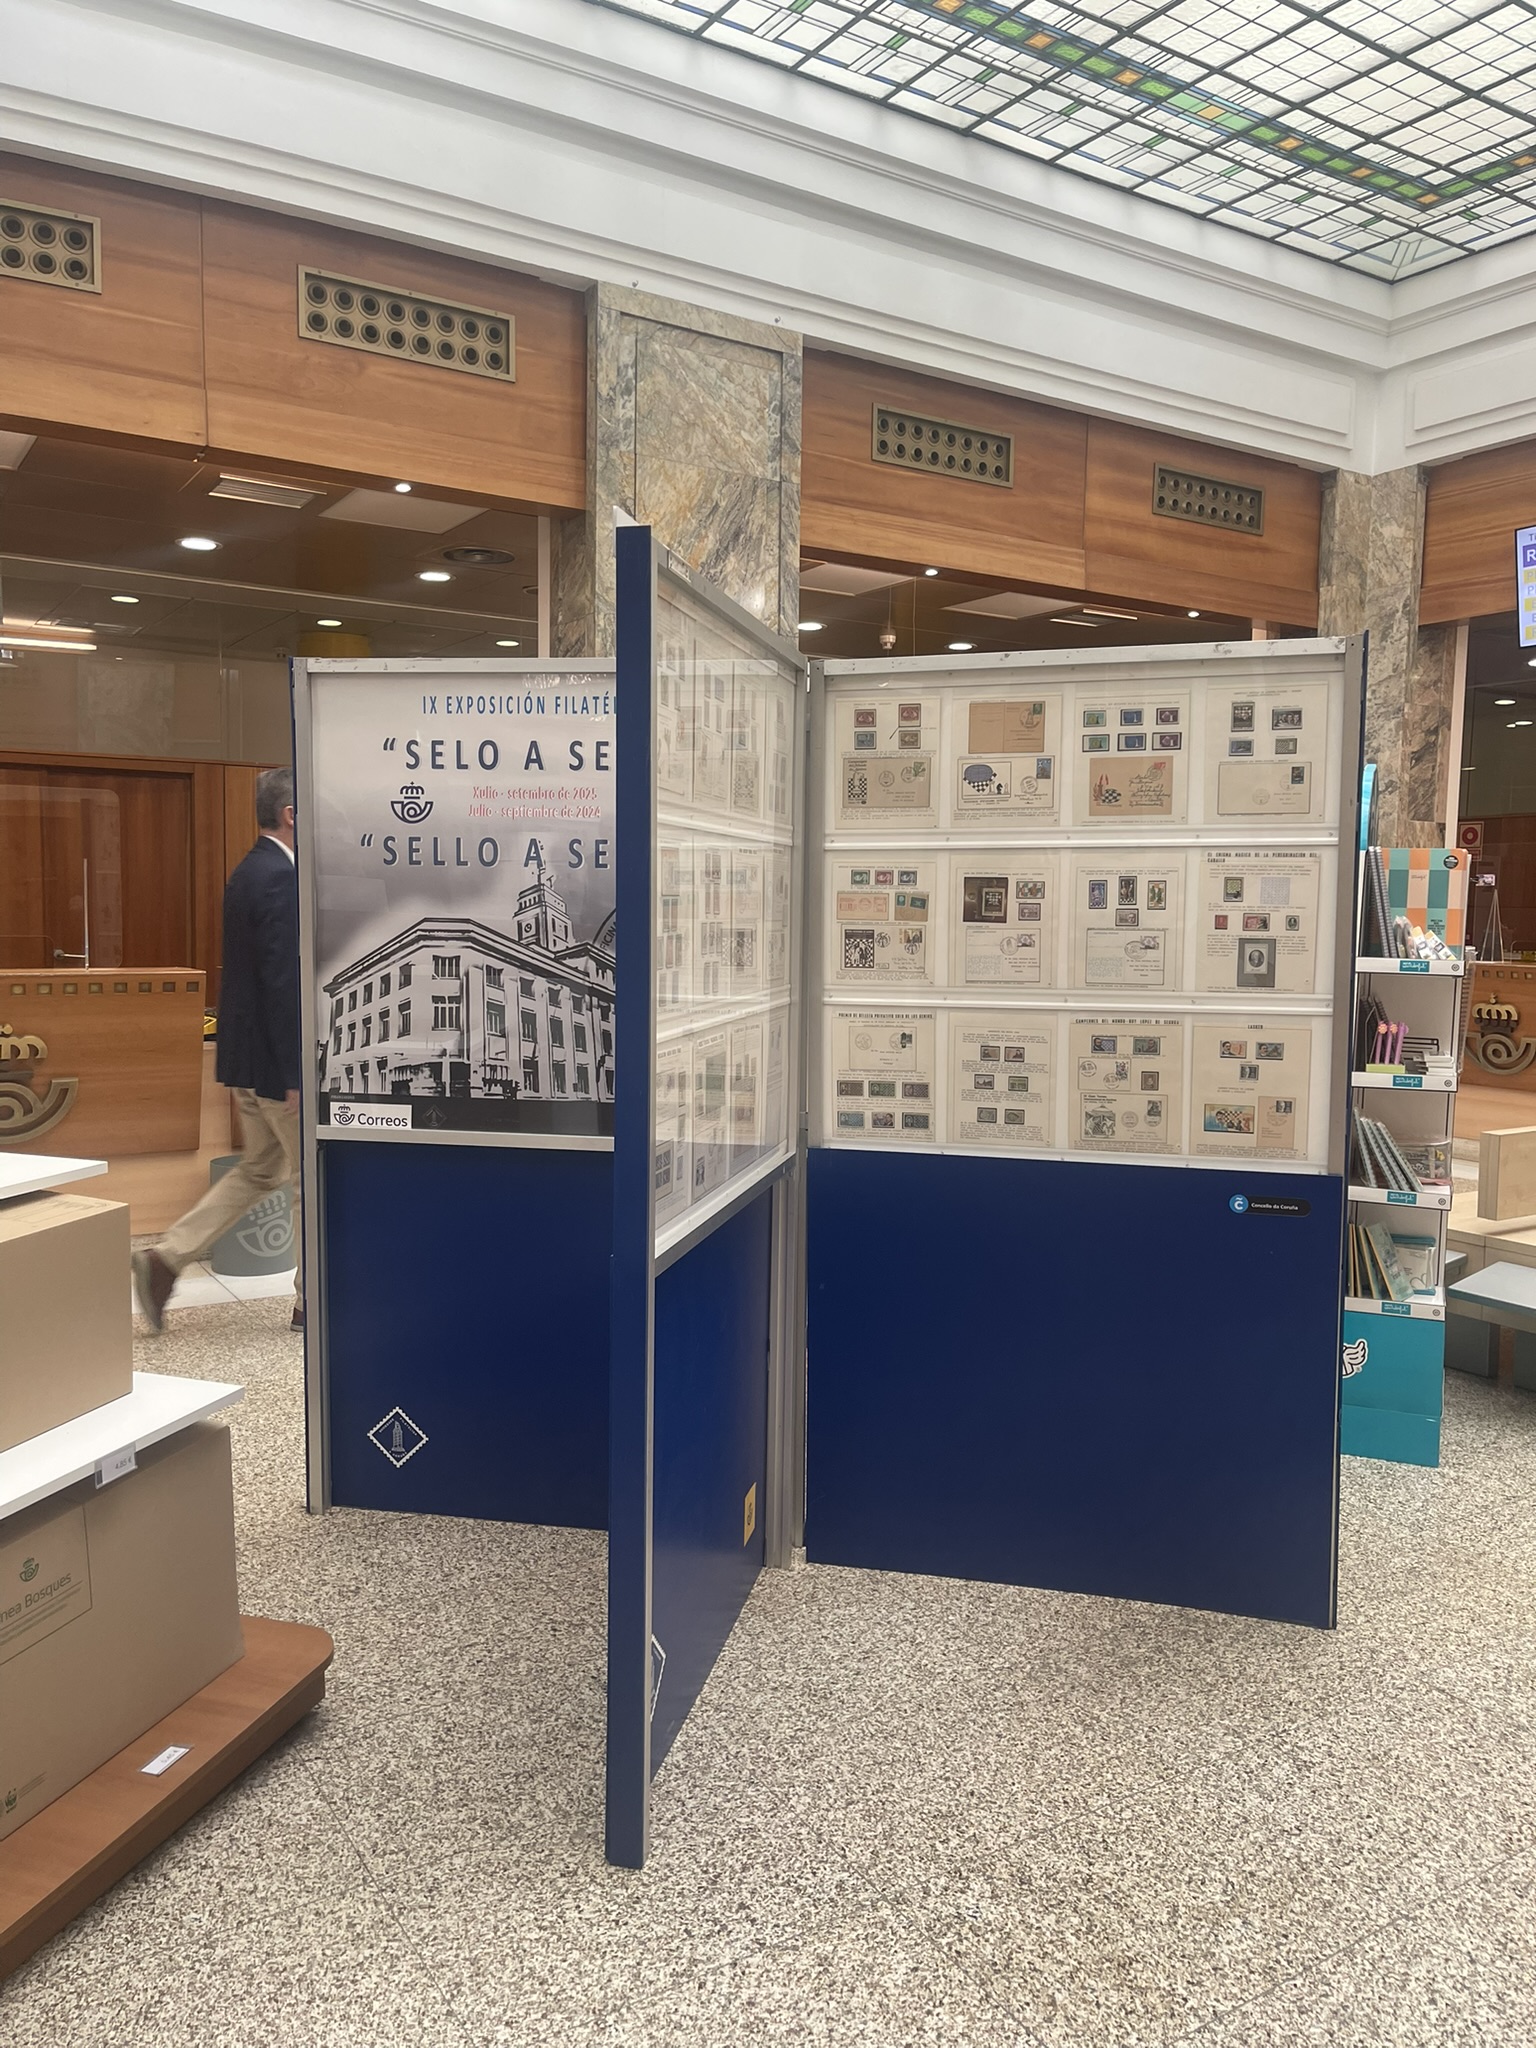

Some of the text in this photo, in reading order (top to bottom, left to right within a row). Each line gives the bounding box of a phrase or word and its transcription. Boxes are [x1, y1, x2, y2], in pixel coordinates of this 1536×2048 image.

[422, 695, 437, 714] IX
[446, 691, 545, 715] EXPOSICIÓN
[524, 740, 544, 771] A
[568, 740, 609, 771] SE
[472, 785, 498, 800] Xulio
[507, 786, 555, 801] setembro
[557, 787, 571, 801] de
[468, 804, 492, 818] Julio
[501, 805, 558, 820] septiembre
[560, 806, 574, 818] de
[523, 838, 544, 868] A
[568, 838, 609, 869] SE
[357, 1113, 408, 1127] Correos
[24, 1572, 72, 1608] Bosques
